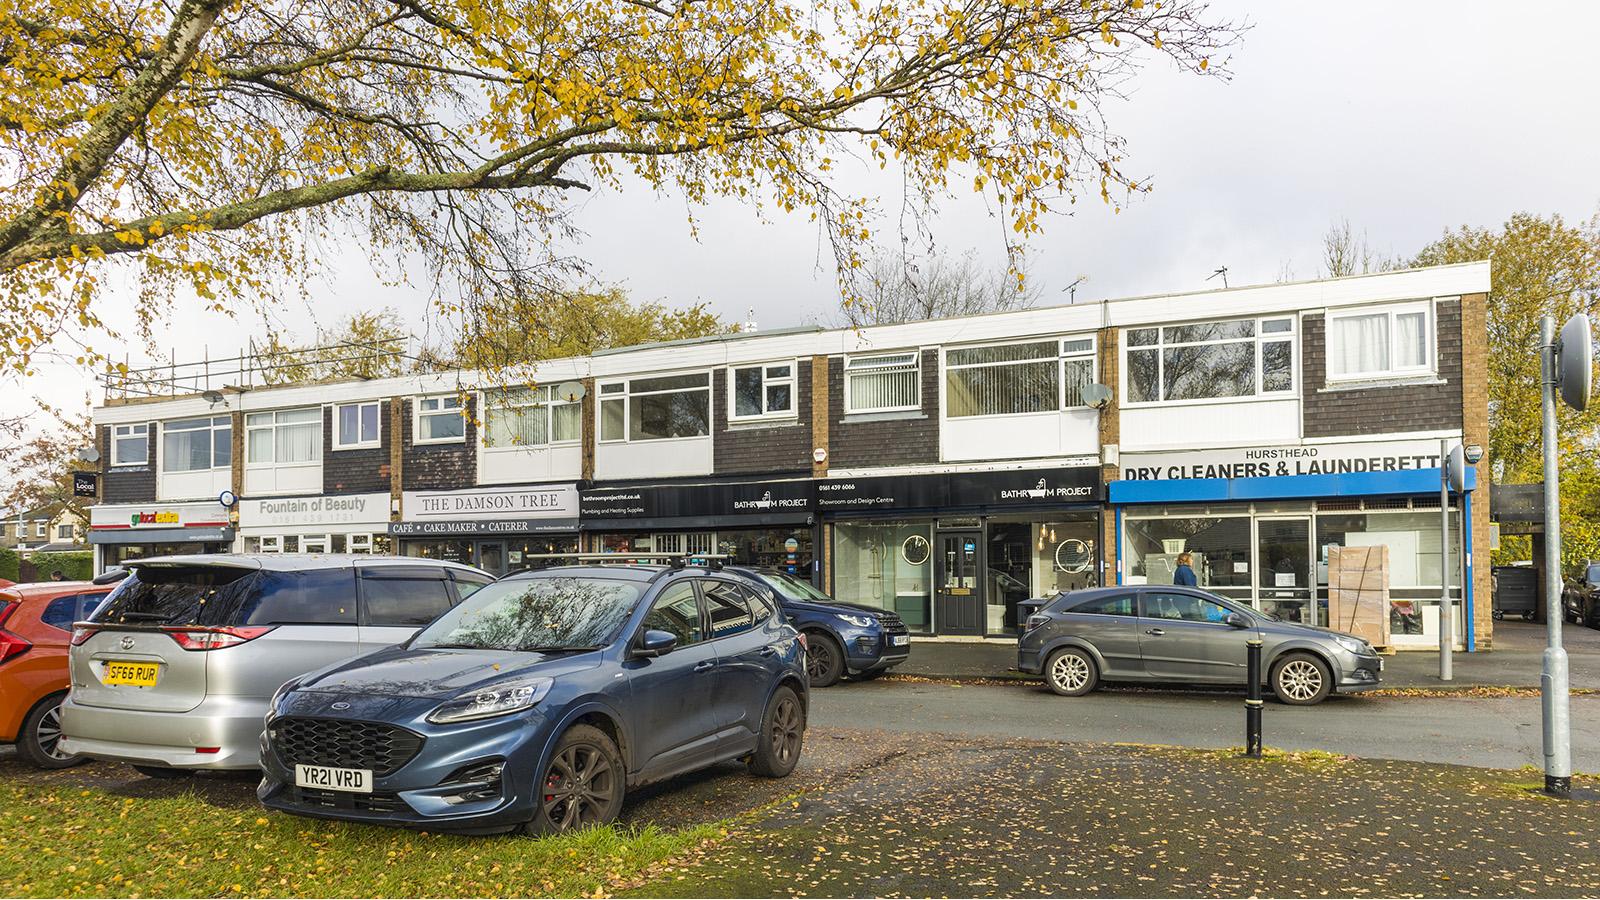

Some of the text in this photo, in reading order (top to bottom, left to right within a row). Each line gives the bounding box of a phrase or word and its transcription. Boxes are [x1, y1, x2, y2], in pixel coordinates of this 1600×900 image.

[1246, 449, 1318, 460] HURSTHEAD
[1125, 467, 1162, 481] DRY
[1167, 461, 1271, 479] CLEANERS
[1275, 461, 1289, 477] &
[1056, 486, 1093, 496] PROJECT
[260, 497, 366, 514] Fountain of Beauty
[422, 494, 559, 511] THE DAMSON TREE
[778, 499, 808, 507] PROJECT
[857, 497, 876, 505] Design
[392, 521, 529, 533] CAFÉ CAKE MAKER CATERER
[111, 666, 155, 680] SF66 RUR
[303, 767, 363, 787] YR21 VRD
